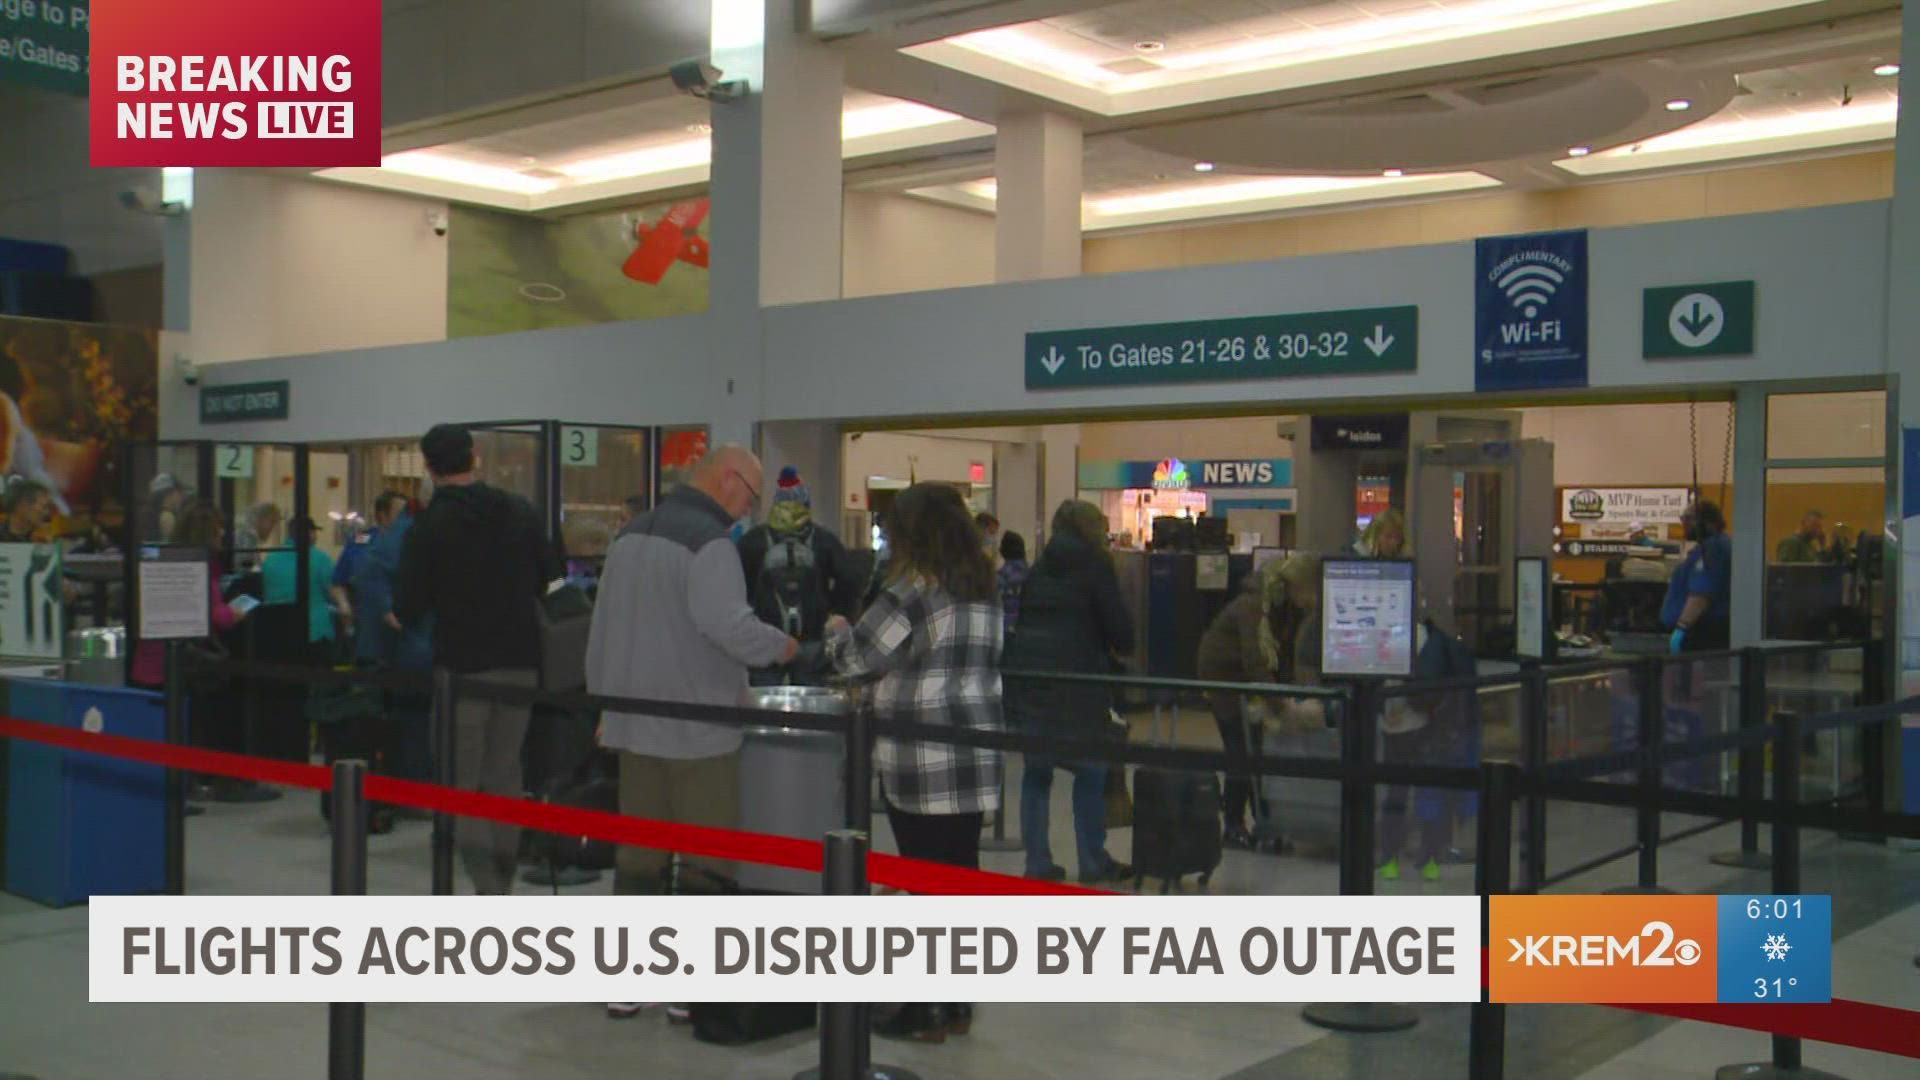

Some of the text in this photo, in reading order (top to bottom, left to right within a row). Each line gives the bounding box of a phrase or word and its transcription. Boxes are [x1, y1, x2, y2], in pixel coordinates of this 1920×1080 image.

[0, 0, 35, 20] ge
[41, 0, 64, 25] to
[1488, 250, 1573, 281] COMPLIMENTARY
[1501, 320, 1561, 344] Wi-Fi
[1078, 331, 1348, 371] To Gates 21-26 & 30-32
[226, 446, 242, 471] 2
[569, 430, 586, 462] 3
[1204, 462, 1273, 484] NEWS
[1608, 493, 1633, 506] MVP
[1662, 495, 1682, 506] Turf
